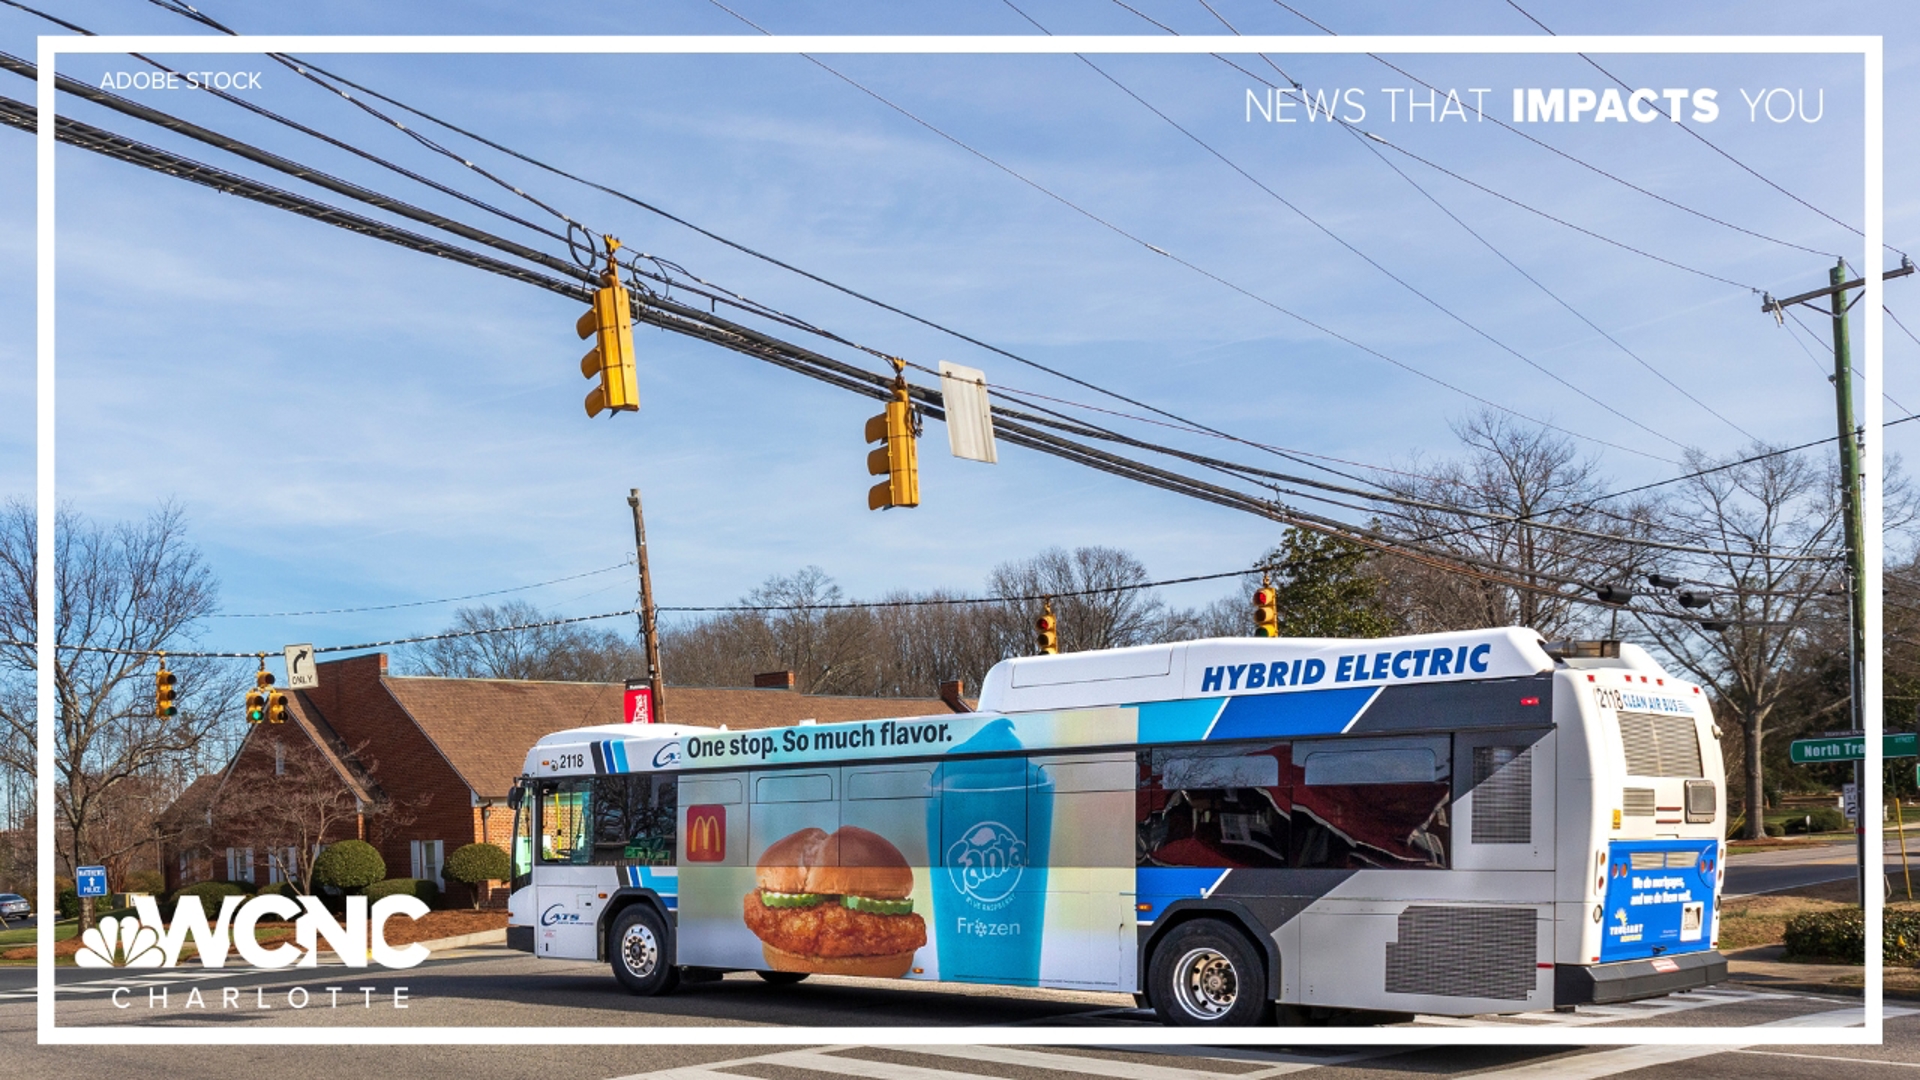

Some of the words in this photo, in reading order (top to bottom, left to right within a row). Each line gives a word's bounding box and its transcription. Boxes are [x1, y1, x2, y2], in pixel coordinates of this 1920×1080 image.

[1201, 659, 1326, 692] HYBRID
[1334, 643, 1491, 683] ELECTRIC
[292, 675, 313, 685] ONLY
[1596, 687, 1624, 710] 2118
[1622, 693, 1648, 709] CLEAN
[687, 737, 725, 758] One
[729, 733, 778, 759] stop.
[782, 729, 809, 752] So
[814, 724, 875, 750] much
[880, 721, 952, 746] flavor.
[1804, 744, 1840, 757] North
[1844, 743, 1866, 755] Tra
[560, 754, 584, 769] 2118
[957, 918, 1021, 937] Frozen
